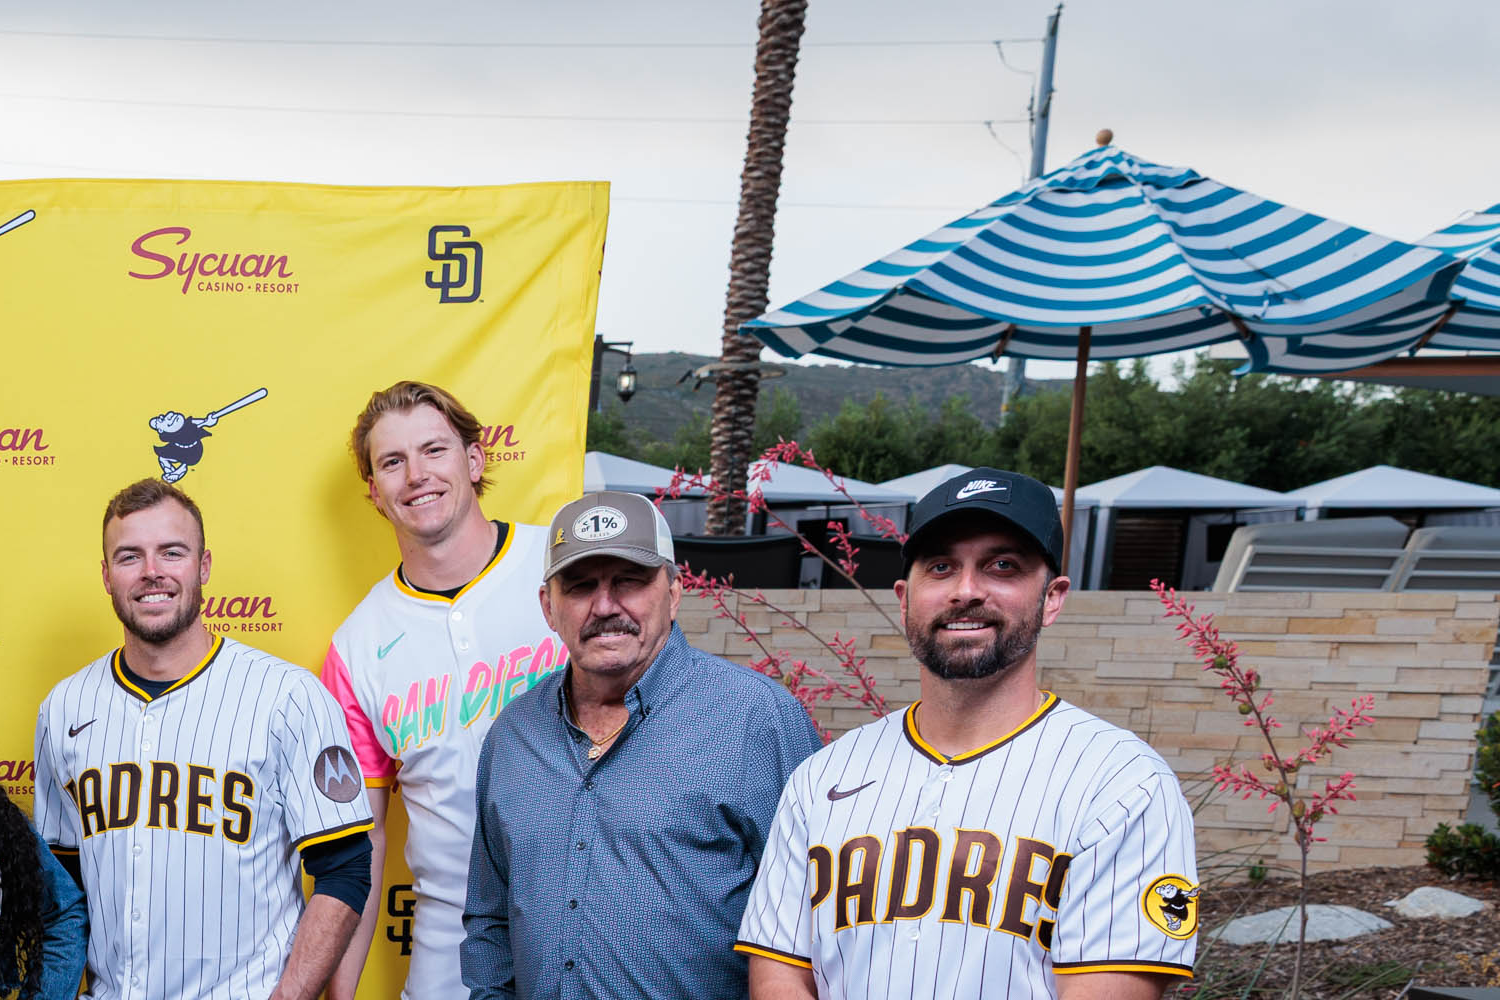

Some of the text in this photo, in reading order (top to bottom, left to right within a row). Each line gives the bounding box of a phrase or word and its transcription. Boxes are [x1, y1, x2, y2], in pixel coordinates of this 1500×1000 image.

[128, 227, 293, 294] Sycuan
[198, 282, 299, 293] CASINO RESORT
[12, 456, 55, 465] RESORT
[964, 480, 997, 491] NIKE
[201, 597, 276, 618] uan
[203, 623, 283, 632] SINO RESORT
[382, 673, 452, 758] SAN
[8, 786, 34, 794] RESO
[63, 761, 254, 845] ADRES
